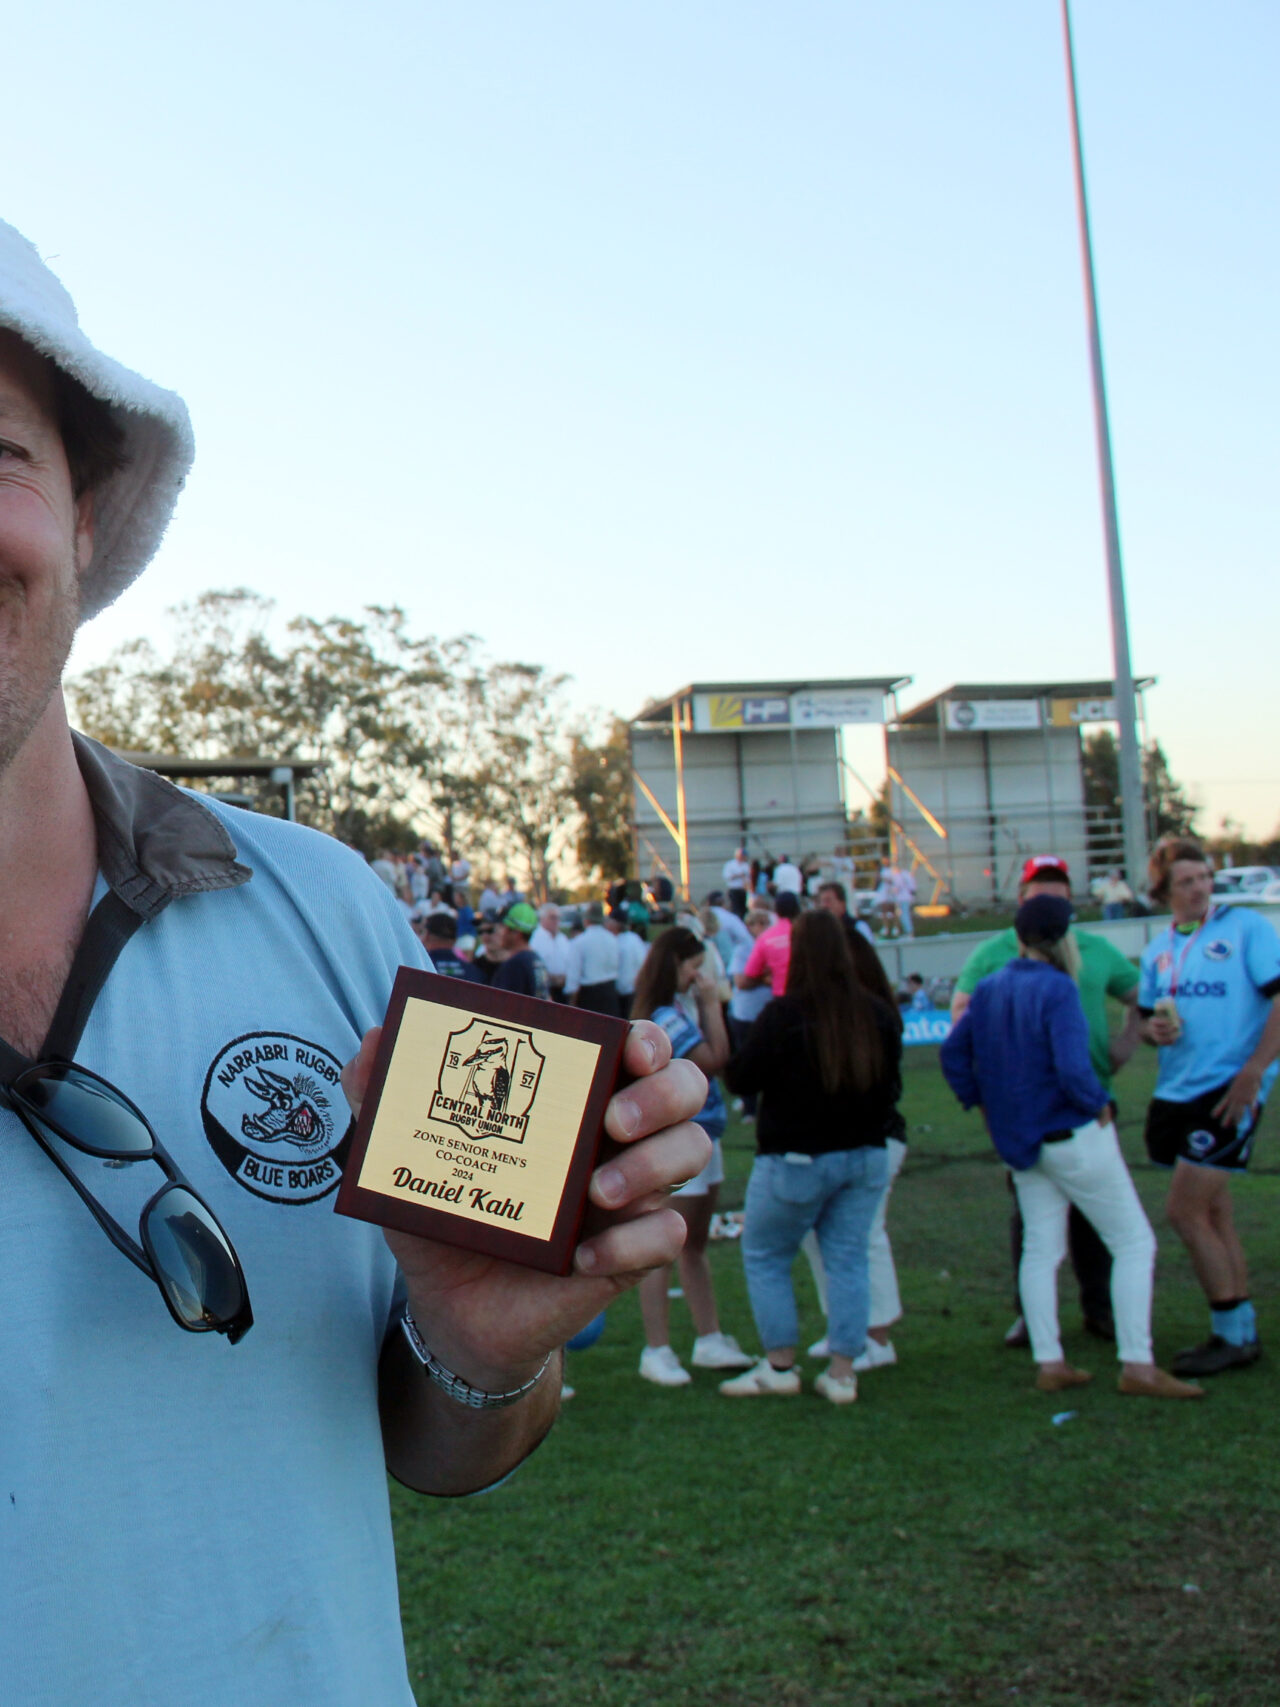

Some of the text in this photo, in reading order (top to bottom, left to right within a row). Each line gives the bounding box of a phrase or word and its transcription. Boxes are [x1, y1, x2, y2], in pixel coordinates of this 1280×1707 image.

[217, 1044, 341, 1088] NARRABRI RUGBY
[449, 1054, 460, 1067] 19
[521, 1073, 535, 1086] 57
[435, 1095, 524, 1129] CENTRAL NORTH
[449, 1112, 504, 1134] RUGBY UNION
[412, 1129, 527, 1168] ZONE SENIOR MEN'S
[435, 1149, 498, 1174] CO-COACH
[243, 1155, 334, 1189] BLUE BOARS
[451, 1167, 474, 1181] 2024
[392, 1166, 525, 1221] Daniel Kahl
